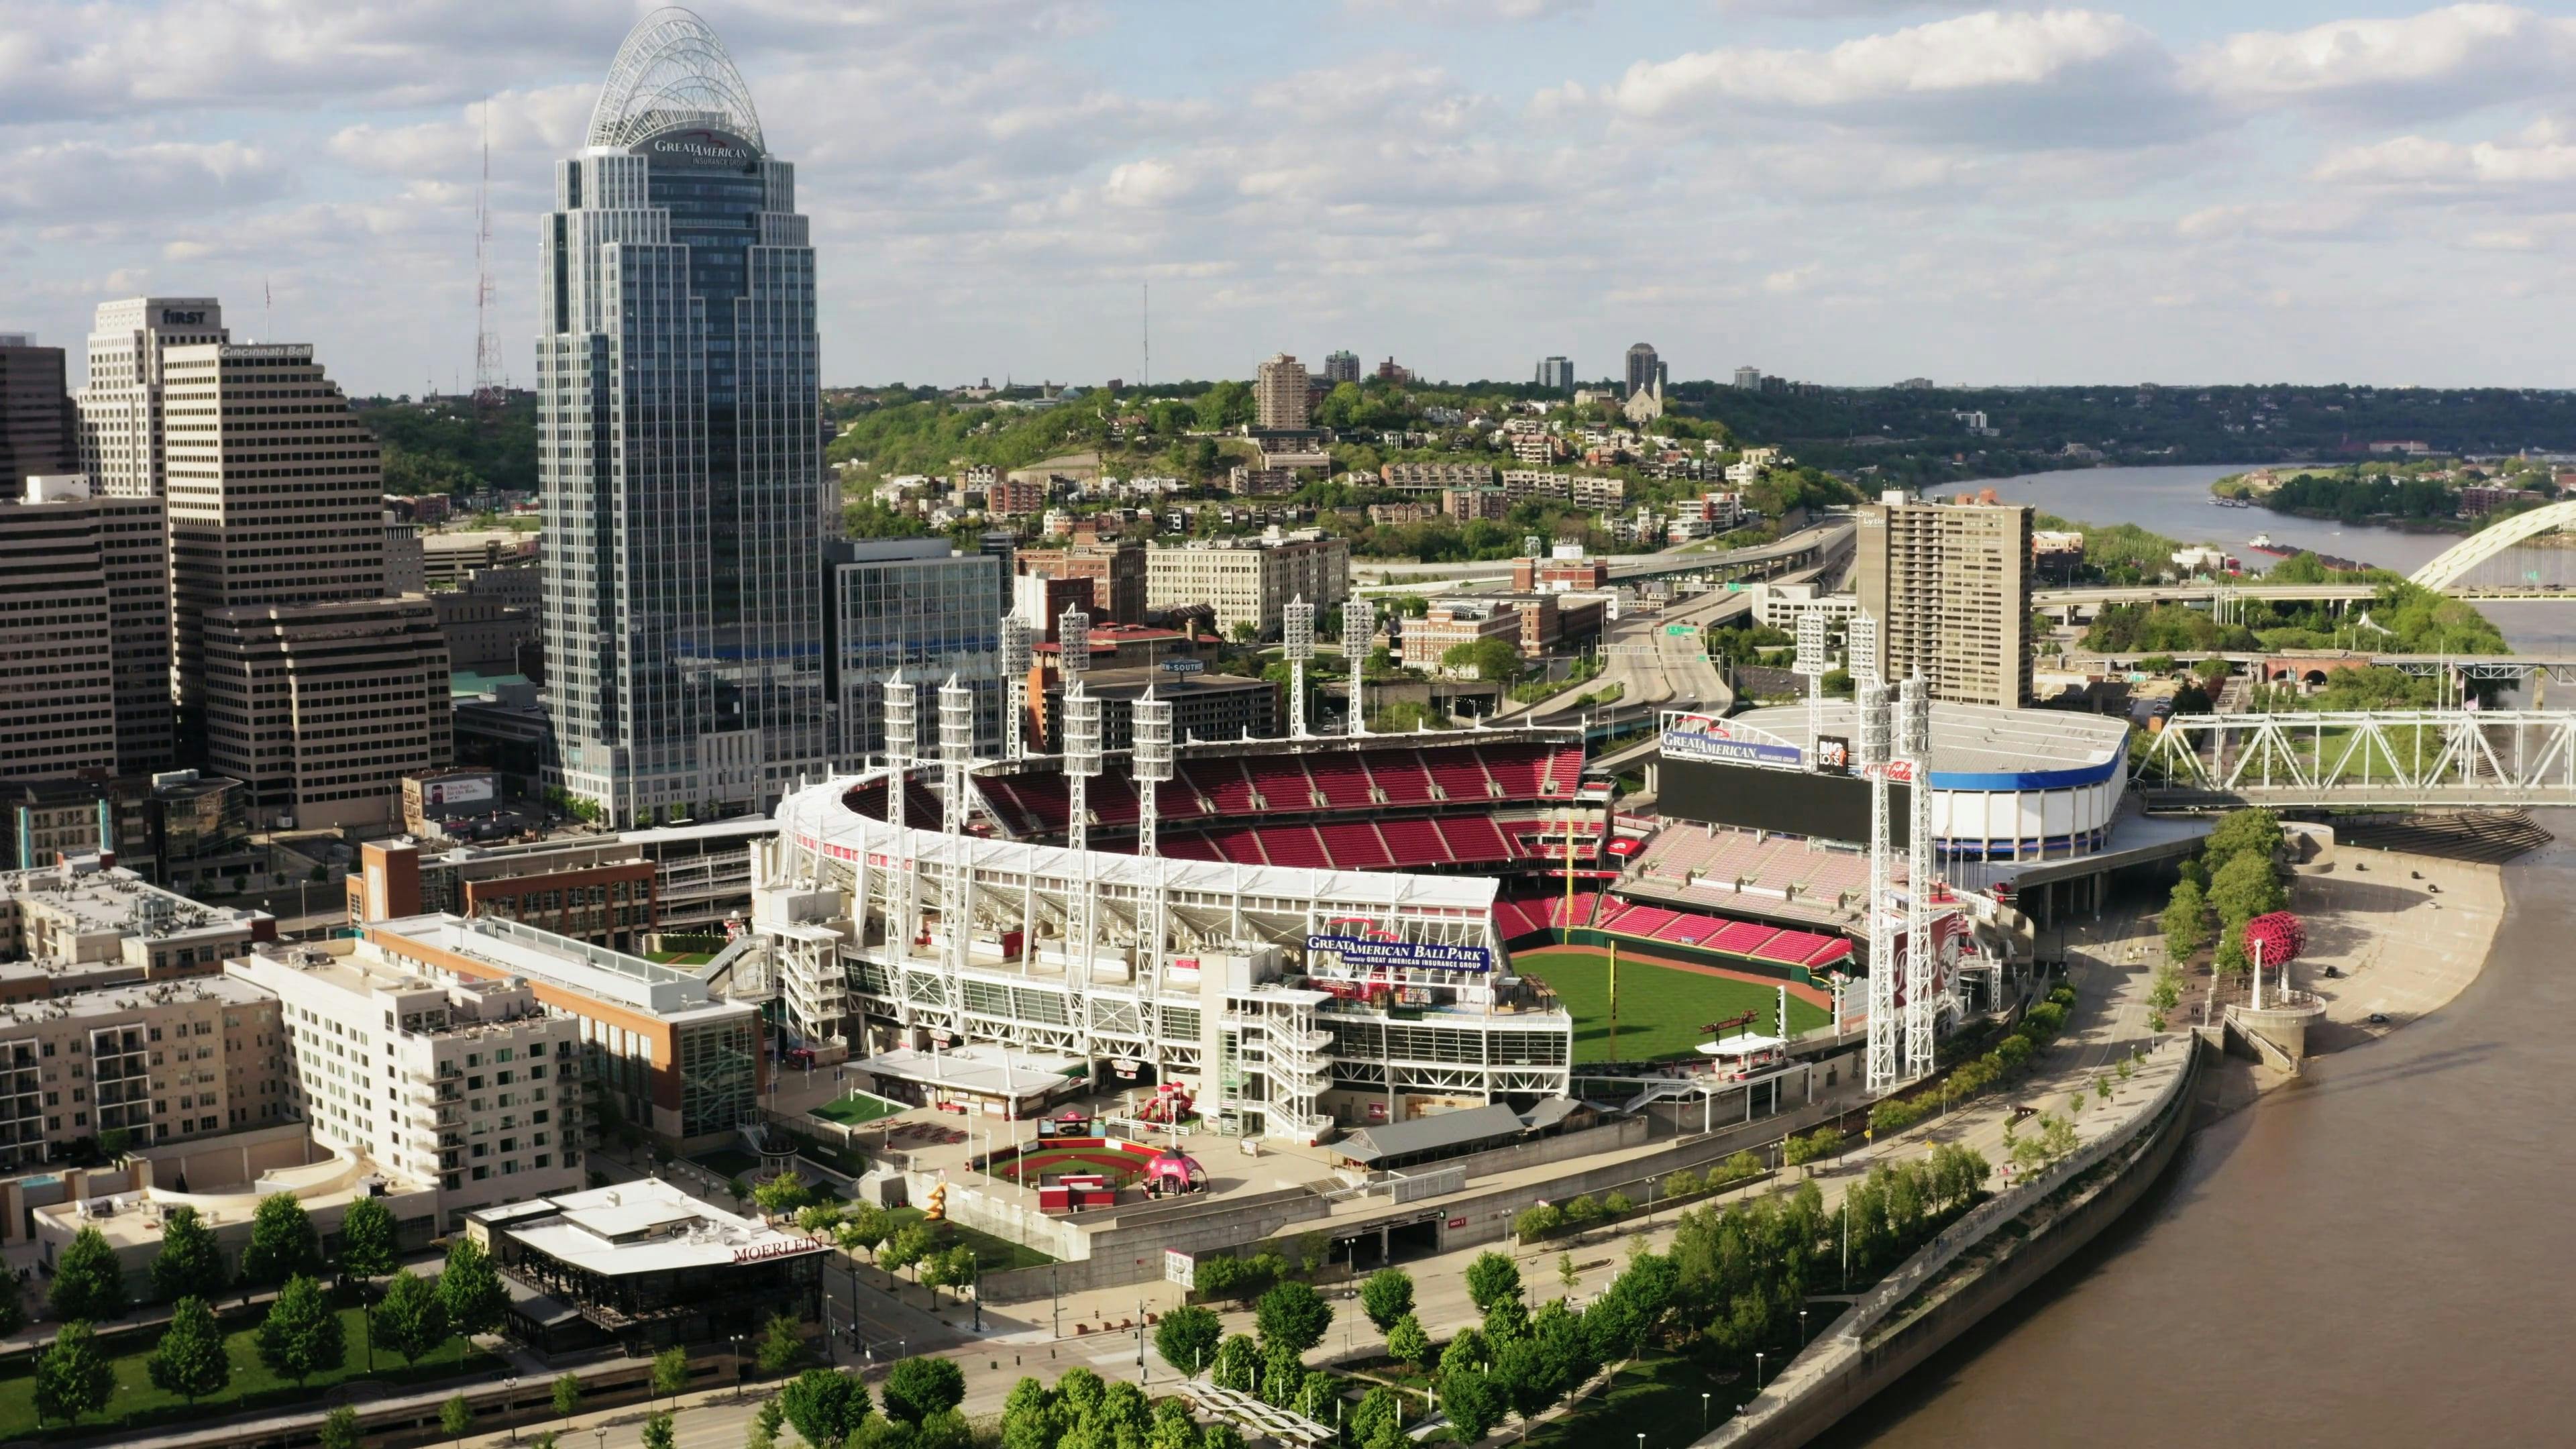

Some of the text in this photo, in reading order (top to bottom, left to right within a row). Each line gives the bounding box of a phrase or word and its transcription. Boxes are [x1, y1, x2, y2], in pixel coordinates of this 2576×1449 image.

[693, 144, 747, 158] AMERICAN
[693, 158, 727, 166] INSURANCE
[219, 345, 311, 357] Cincinnati Bell
[1663, 733, 1703, 749] GREAT
[1697, 743, 1758, 759] AMERICAN
[1819, 741, 1843, 755] BIG
[1308, 936, 1351, 949] GREAT
[1346, 942, 1410, 957] AMERICAN
[1421, 959, 1457, 967] INSURANCE
[733, 1235, 823, 1262] MOERLEIN
